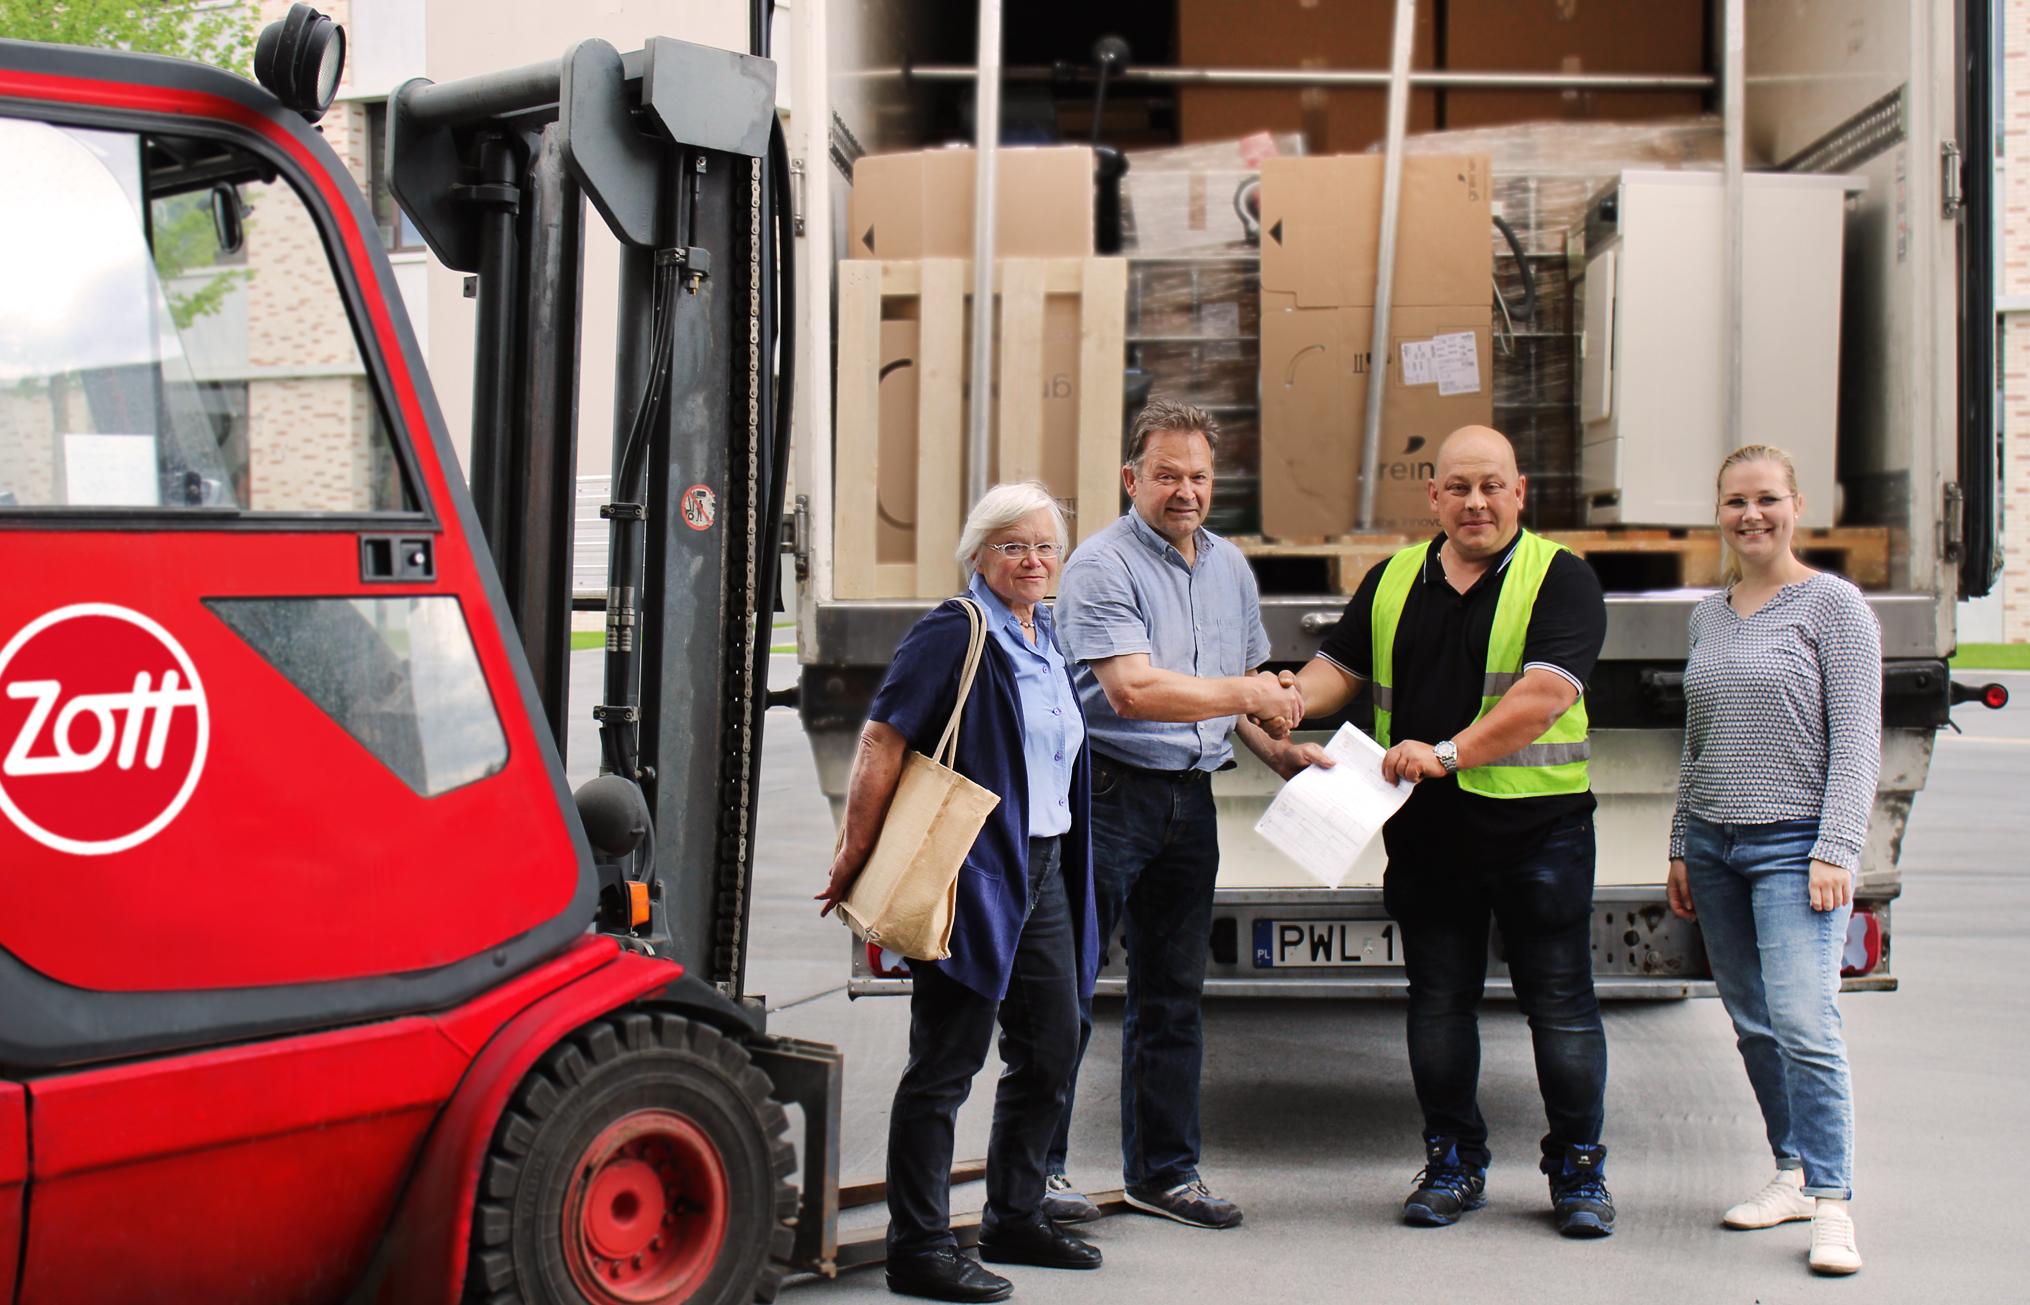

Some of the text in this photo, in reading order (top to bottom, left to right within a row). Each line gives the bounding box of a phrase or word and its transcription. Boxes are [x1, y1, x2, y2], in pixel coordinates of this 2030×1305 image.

[3, 669, 202, 776] Zott
[1257, 949, 1271, 959] PL
[1279, 924, 1394, 962] PWL 1
